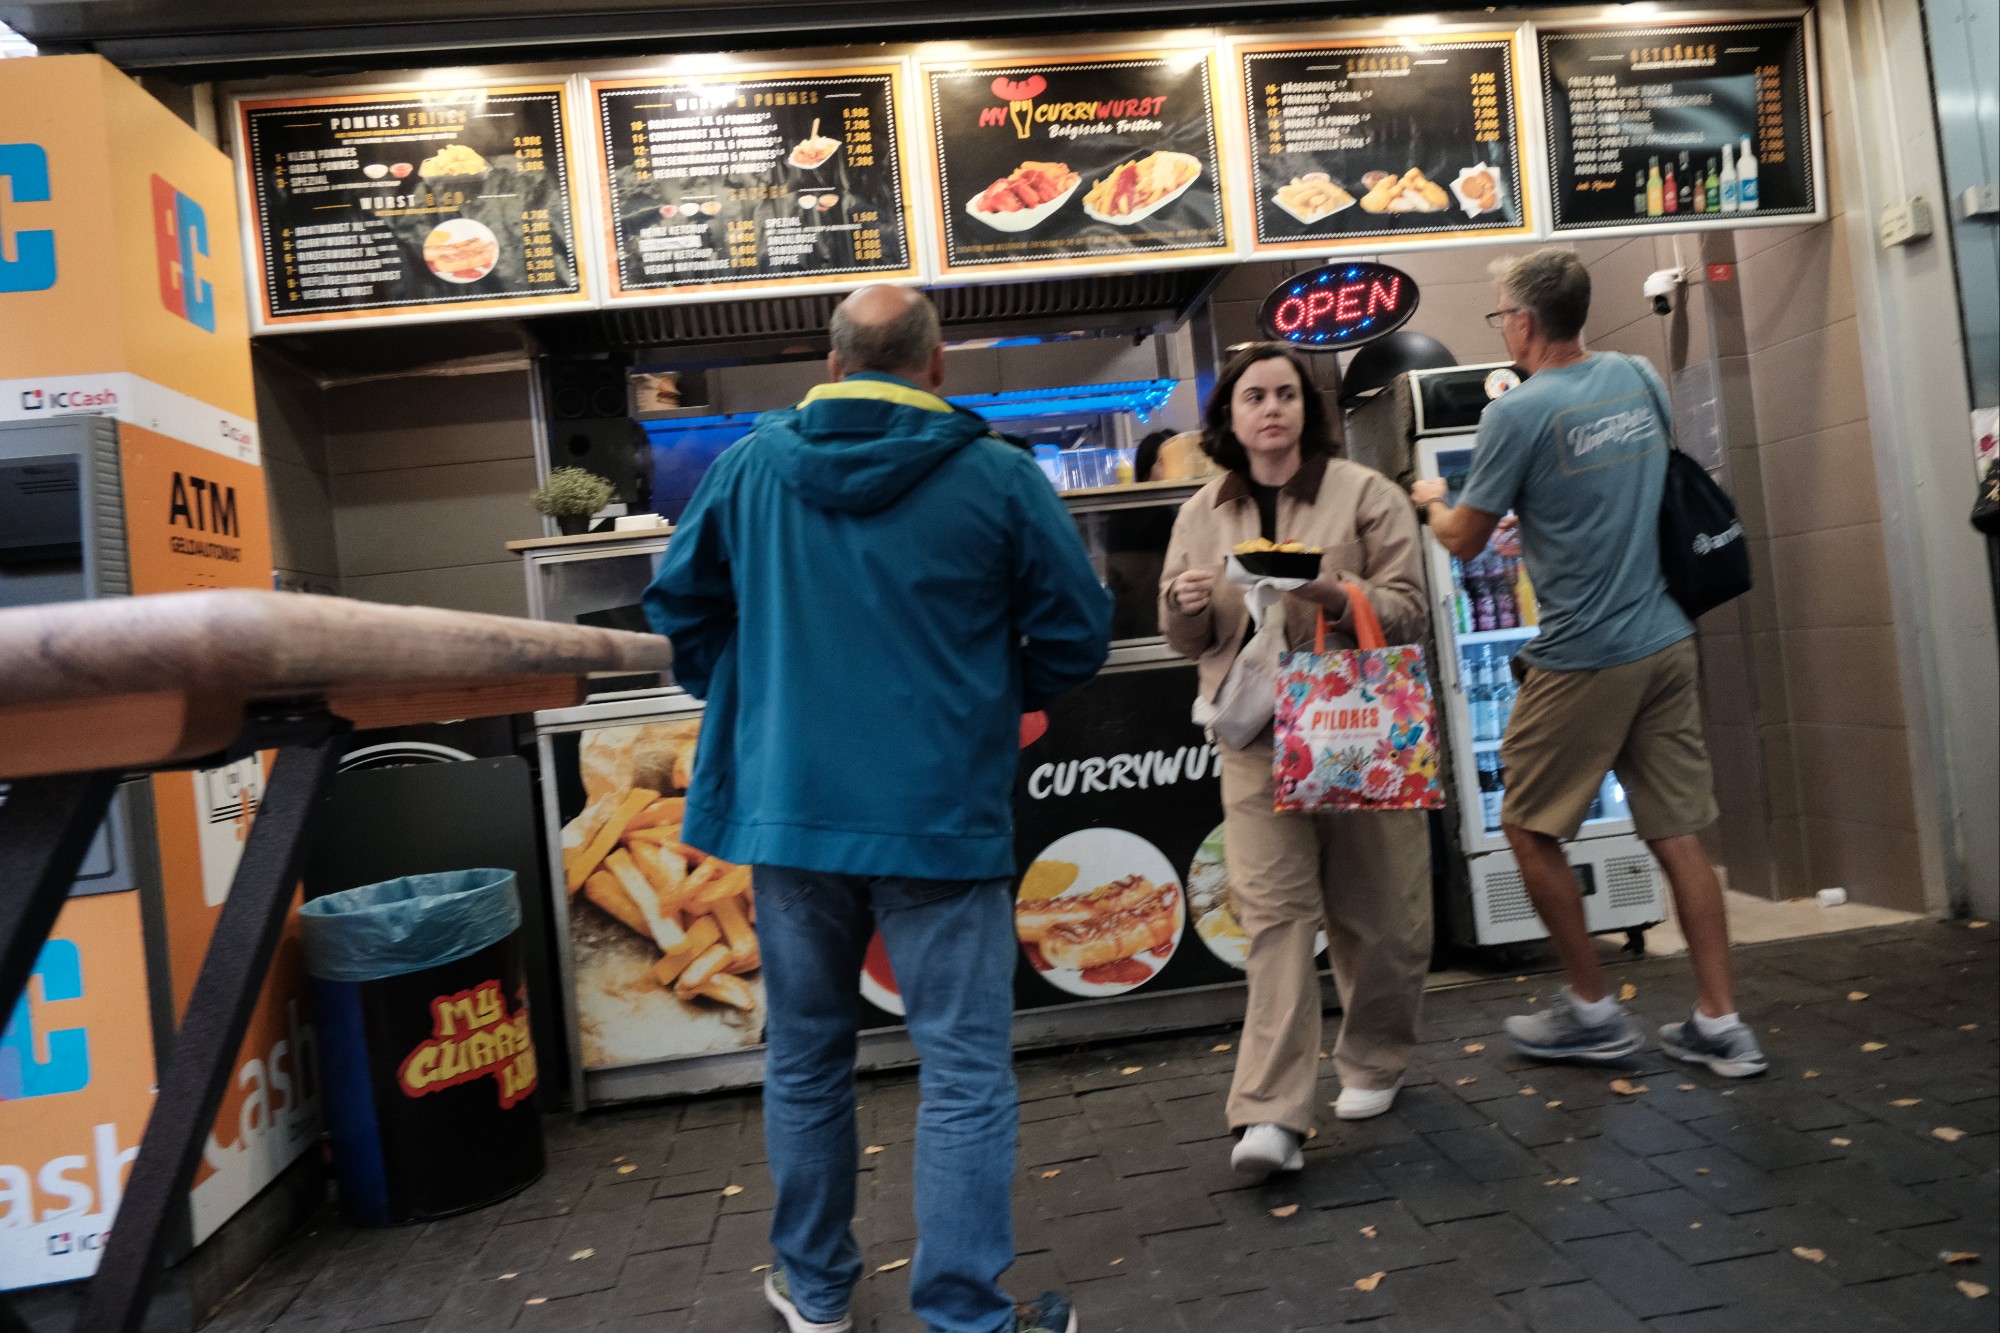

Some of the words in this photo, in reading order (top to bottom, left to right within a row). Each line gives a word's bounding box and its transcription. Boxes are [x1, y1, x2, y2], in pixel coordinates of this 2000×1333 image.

[754, 91, 819, 107] POMMES
[978, 106, 1008, 128] MY
[1034, 96, 1167, 124] CURRYWURST
[1048, 121, 1114, 140] Belgische
[1116, 118, 1162, 134] Fritten
[360, 194, 416, 210] WURST
[1274, 275, 1401, 332] OPEN
[169, 471, 240, 538] ATM
[437, 988, 501, 1036] MY
[404, 1015, 530, 1089] CURRY
